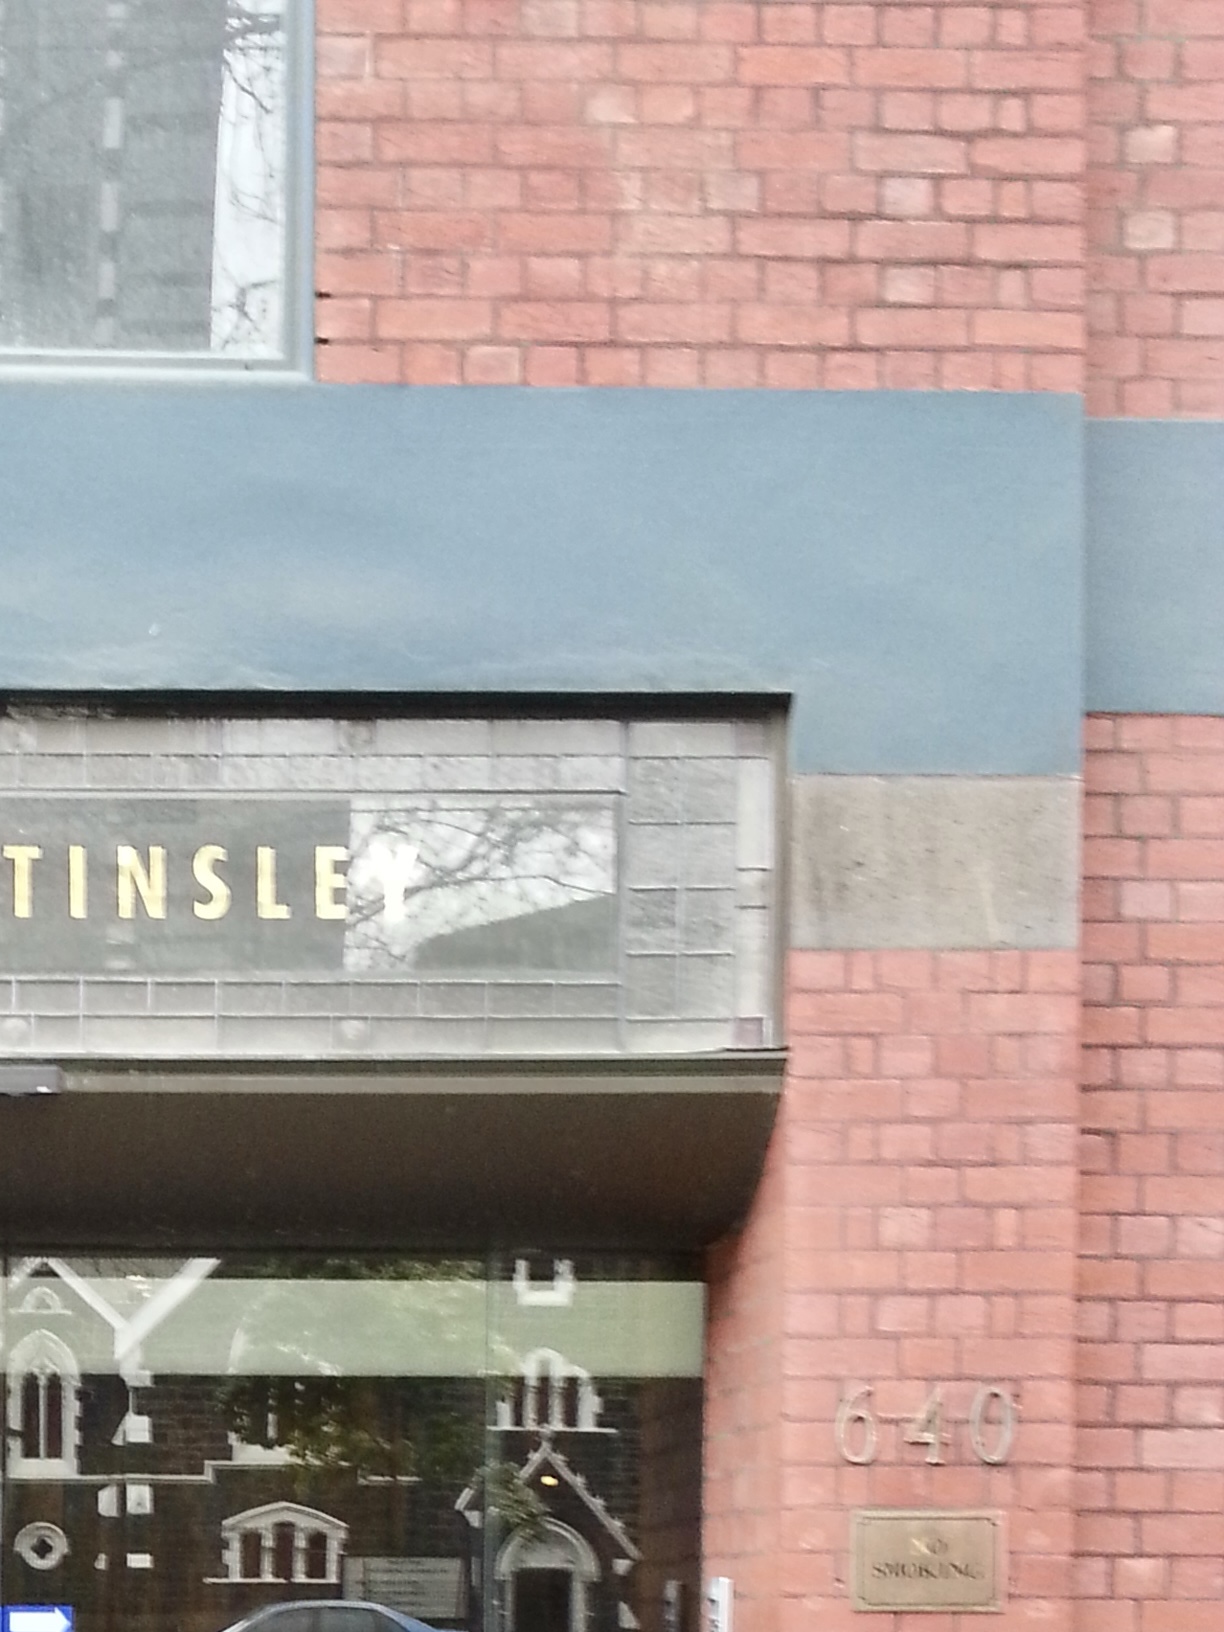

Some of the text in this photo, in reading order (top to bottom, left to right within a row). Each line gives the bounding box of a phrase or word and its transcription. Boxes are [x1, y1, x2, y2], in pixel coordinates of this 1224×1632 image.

[3, 844, 419, 922] TINSLEY
[835, 1385, 1014, 1466] 640
[871, 1561, 985, 1579] SMOKING
